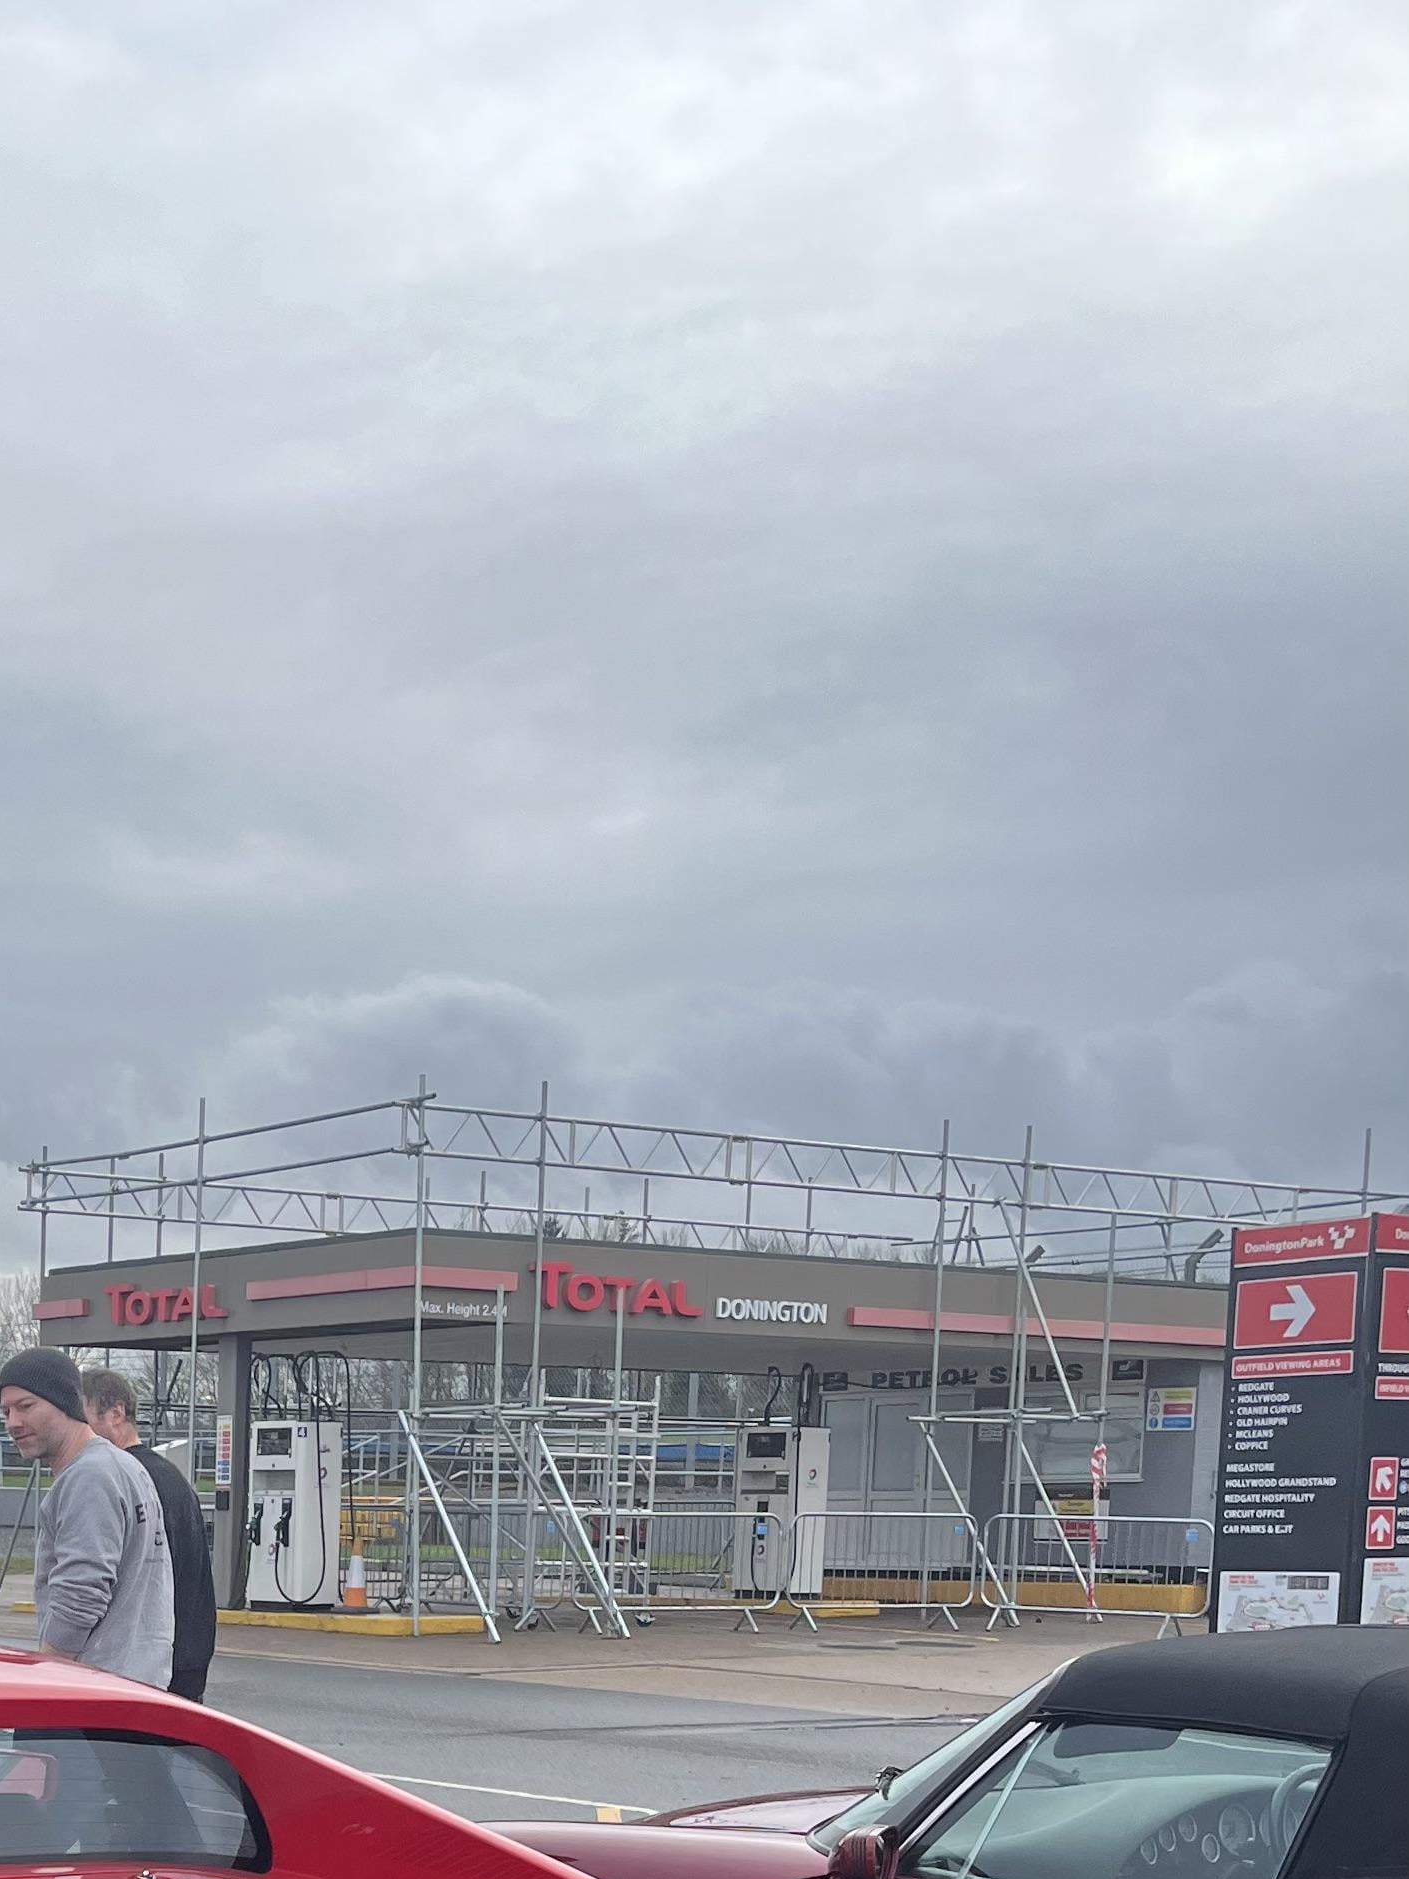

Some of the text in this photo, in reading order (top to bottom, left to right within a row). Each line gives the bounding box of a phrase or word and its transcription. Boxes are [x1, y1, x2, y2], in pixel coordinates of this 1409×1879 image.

[529, 1261, 704, 1319] TOTAL
[105, 1283, 229, 1326] TOTAL
[446, 1302, 480, 1318] Height
[716, 1297, 827, 1324] DONINGTON
[1236, 1358, 1341, 1372] OUTFIELD VIEWING AREAS
[1238, 1382, 1275, 1392] REDGATE
[1237, 1393, 1290, 1403] HOLLYWOOD
[1270, 1404, 1303, 1414] CURVES
[1236, 1418, 1254, 1427] OLD
[1235, 1441, 1269, 1450] COPPICE
[1226, 1463, 1275, 1472] MEGASTORE
[1225, 1477, 1337, 1488] HOLLYWOOD GRANDSTAND
[1224, 1493, 1315, 1503] REDGATE HOSPITALITY
[1223, 1509, 1285, 1519] CIRCUIT OFFICE
[1222, 1525, 1239, 1534] CAR
